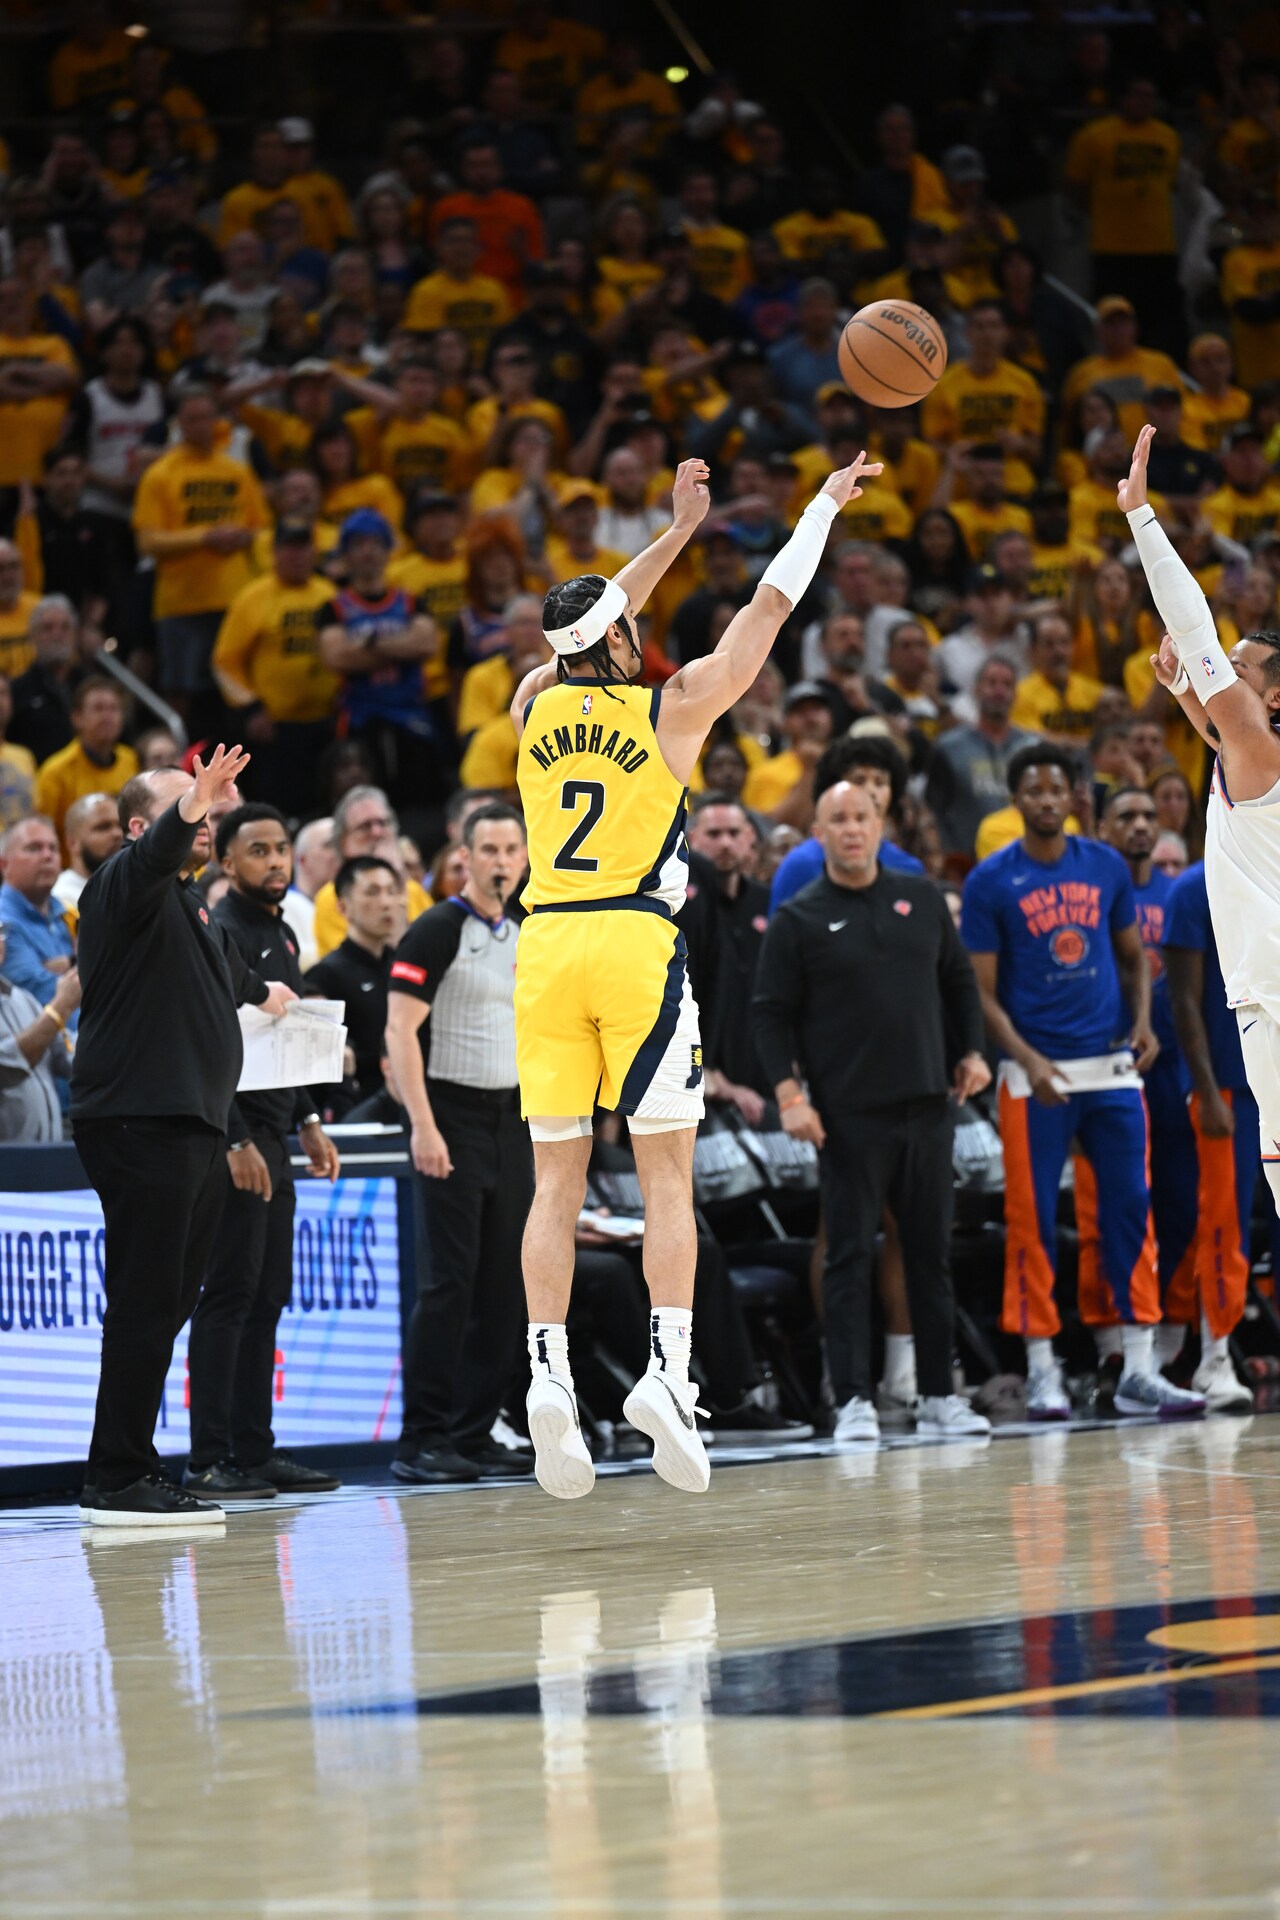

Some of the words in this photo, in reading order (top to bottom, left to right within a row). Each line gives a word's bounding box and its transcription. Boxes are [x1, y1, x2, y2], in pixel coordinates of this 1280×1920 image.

[880, 309, 937, 363] Wilson
[529, 723, 649, 774] NEMBHARD
[553, 779, 605, 873] 2
[1018, 883, 1057, 919] NEW
[1058, 881, 1101, 907] YORK
[1026, 902, 1101, 939] FOREVER
[0, 1229, 105, 1331] UGGETS
[288, 1215, 377, 1313] OLVES
